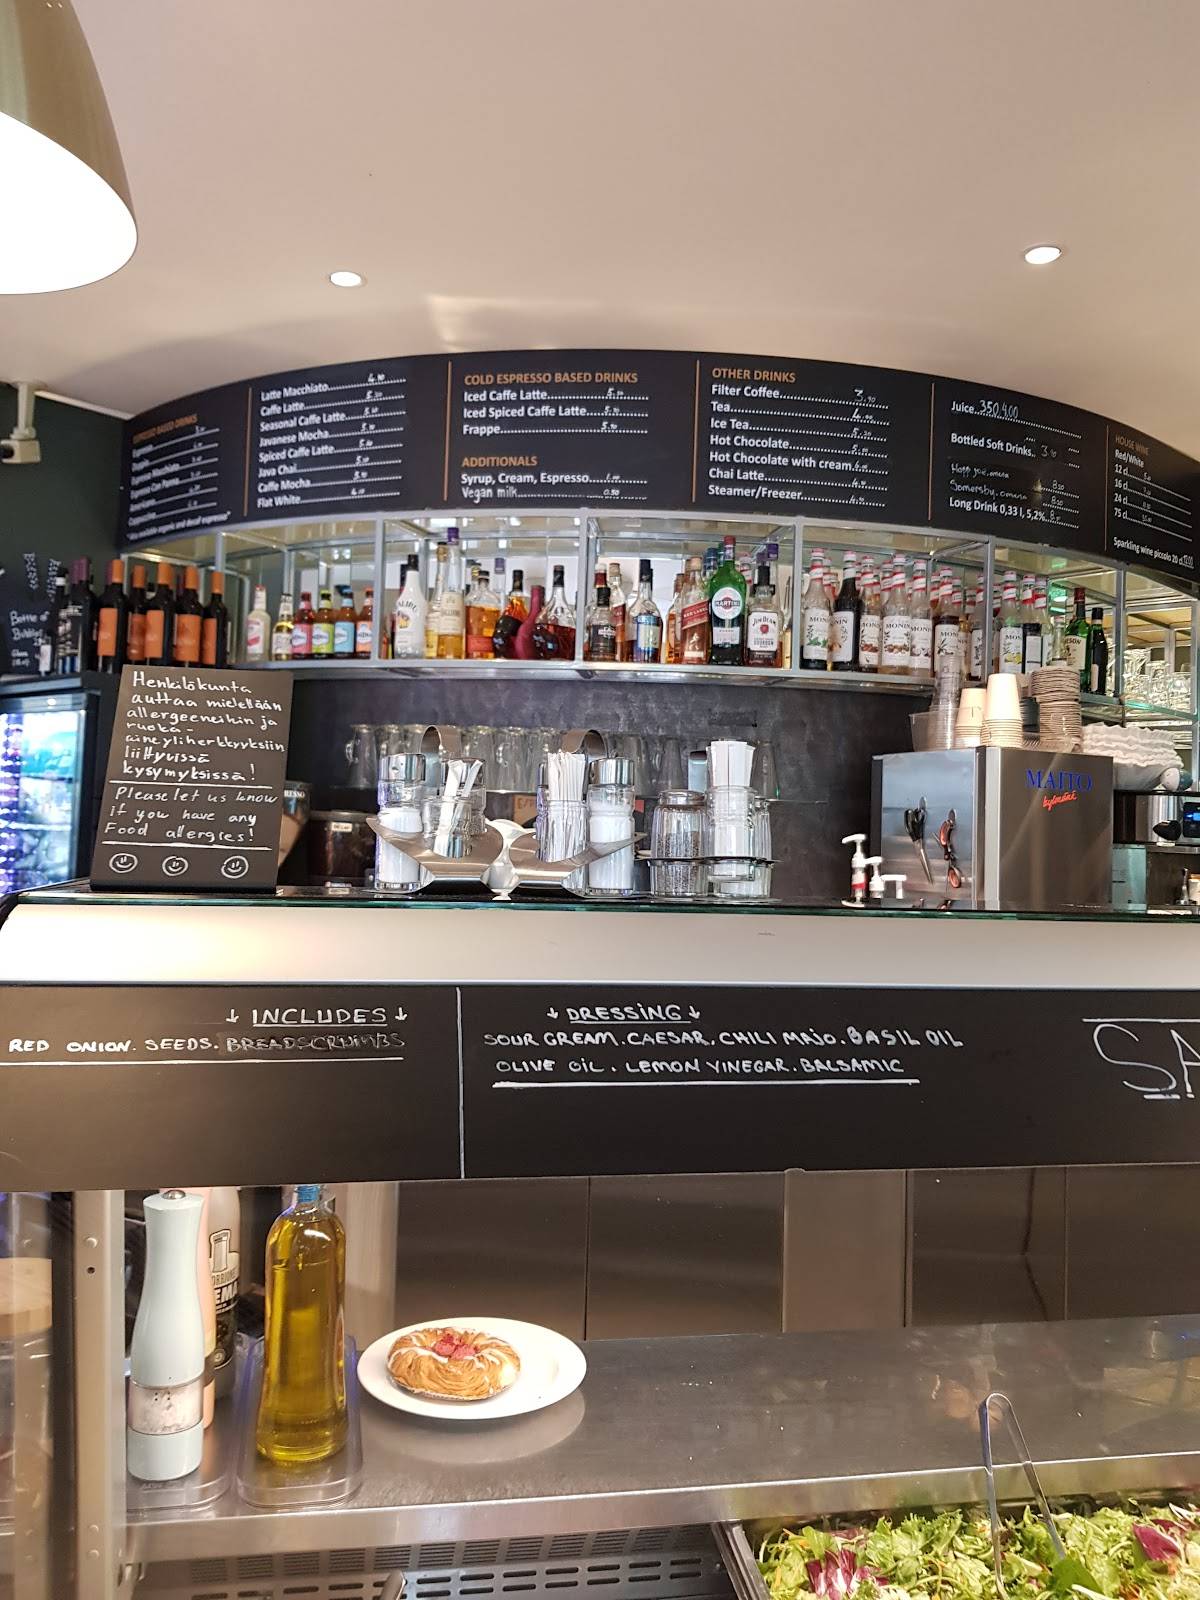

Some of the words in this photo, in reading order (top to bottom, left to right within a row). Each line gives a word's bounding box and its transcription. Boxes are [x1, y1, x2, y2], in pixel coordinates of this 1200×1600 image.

[464, 374, 493, 386] COLD
[496, 373, 551, 385] ESPRESSO
[554, 373, 592, 384] BASED
[595, 372, 638, 384] DRINKS
[712, 368, 751, 380] OTHER
[753, 370, 796, 383] DRINKS
[261, 390, 282, 402] Latte
[283, 383, 329, 398] Macchiato
[463, 391, 486, 402] Iced
[489, 389, 517, 401] Caffe
[520, 388, 547, 400] Latte
[711, 384, 741, 397] Filter
[743, 386, 780, 399] Coffee
[260, 404, 282, 417] Caffe
[283, 402, 305, 413] Latte
[463, 408, 486, 419] Iced
[489, 406, 524, 420] Spiced
[527, 405, 556, 418] Caffe
[558, 405, 587, 417] Latte
[710, 401, 731, 412] Tea
[951, 401, 974, 414] Juice
[260, 417, 298, 432] Seasonal
[298, 414, 321, 426] Caffe
[323, 411, 345, 423] Latte
[710, 418, 727, 429] Ice
[729, 419, 749, 430] Tea
[259, 434, 297, 448] Javanese
[298, 428, 329, 442] Mocha
[462, 424, 501, 437] Frappe
[710, 434, 731, 446] Hot
[733, 435, 790, 450] Chocolate
[951, 432, 985, 448] Bottled
[986, 439, 1004, 452] Soft
[1005, 442, 1032, 458] Drinks
[259, 448, 287, 464] Spiced
[288, 446, 310, 459] Caffe
[312, 444, 335, 456] Latte
[462, 456, 538, 467] ADDITIONALS
[709, 451, 731, 463] Hot
[733, 452, 789, 466] Chocolate
[791, 457, 816, 468] with
[818, 460, 852, 471] cream
[258, 468, 276, 479] Java
[461, 473, 496, 486] Syrup,
[498, 473, 538, 485] Cream,
[540, 473, 589, 485] Espresso
[708, 467, 734, 479] Chai
[737, 469, 765, 481] Latte
[257, 481, 280, 494] Caffe
[281, 478, 311, 491] Mocha
[708, 485, 802, 500] Steamer/Freezer
[274, 494, 301, 506] White
[462, 487, 493, 503] Vegan
[497, 486, 518, 498] milk
[949, 497, 972, 512] Long
[973, 500, 998, 514] Drink
[1000, 504, 1018, 517] 0,33
[131, 692, 198, 708] auttaa
[260, 714, 278, 731] ja
[1025, 768, 1093, 791] MAITO
[115, 786, 168, 801] Please
[173, 787, 200, 802] let
[207, 794, 227, 803] us
[235, 791, 278, 804] know
[134, 809, 170, 824] you
[182, 808, 216, 822] have
[228, 815, 257, 827] any
[104, 822, 149, 837] Food
[252, 1008, 388, 1025] INCLUDES
[483, 1032, 540, 1046] SOUR
[719, 1031, 778, 1046] CHILI
[847, 1026, 921, 1046] BASIL
[925, 1029, 964, 1047] OIL
[8, 1038, 50, 1052] RED
[496, 1059, 556, 1073] OLIVE
[625, 1058, 701, 1073] LEMON
[799, 1058, 905, 1073] BALSAMIC
